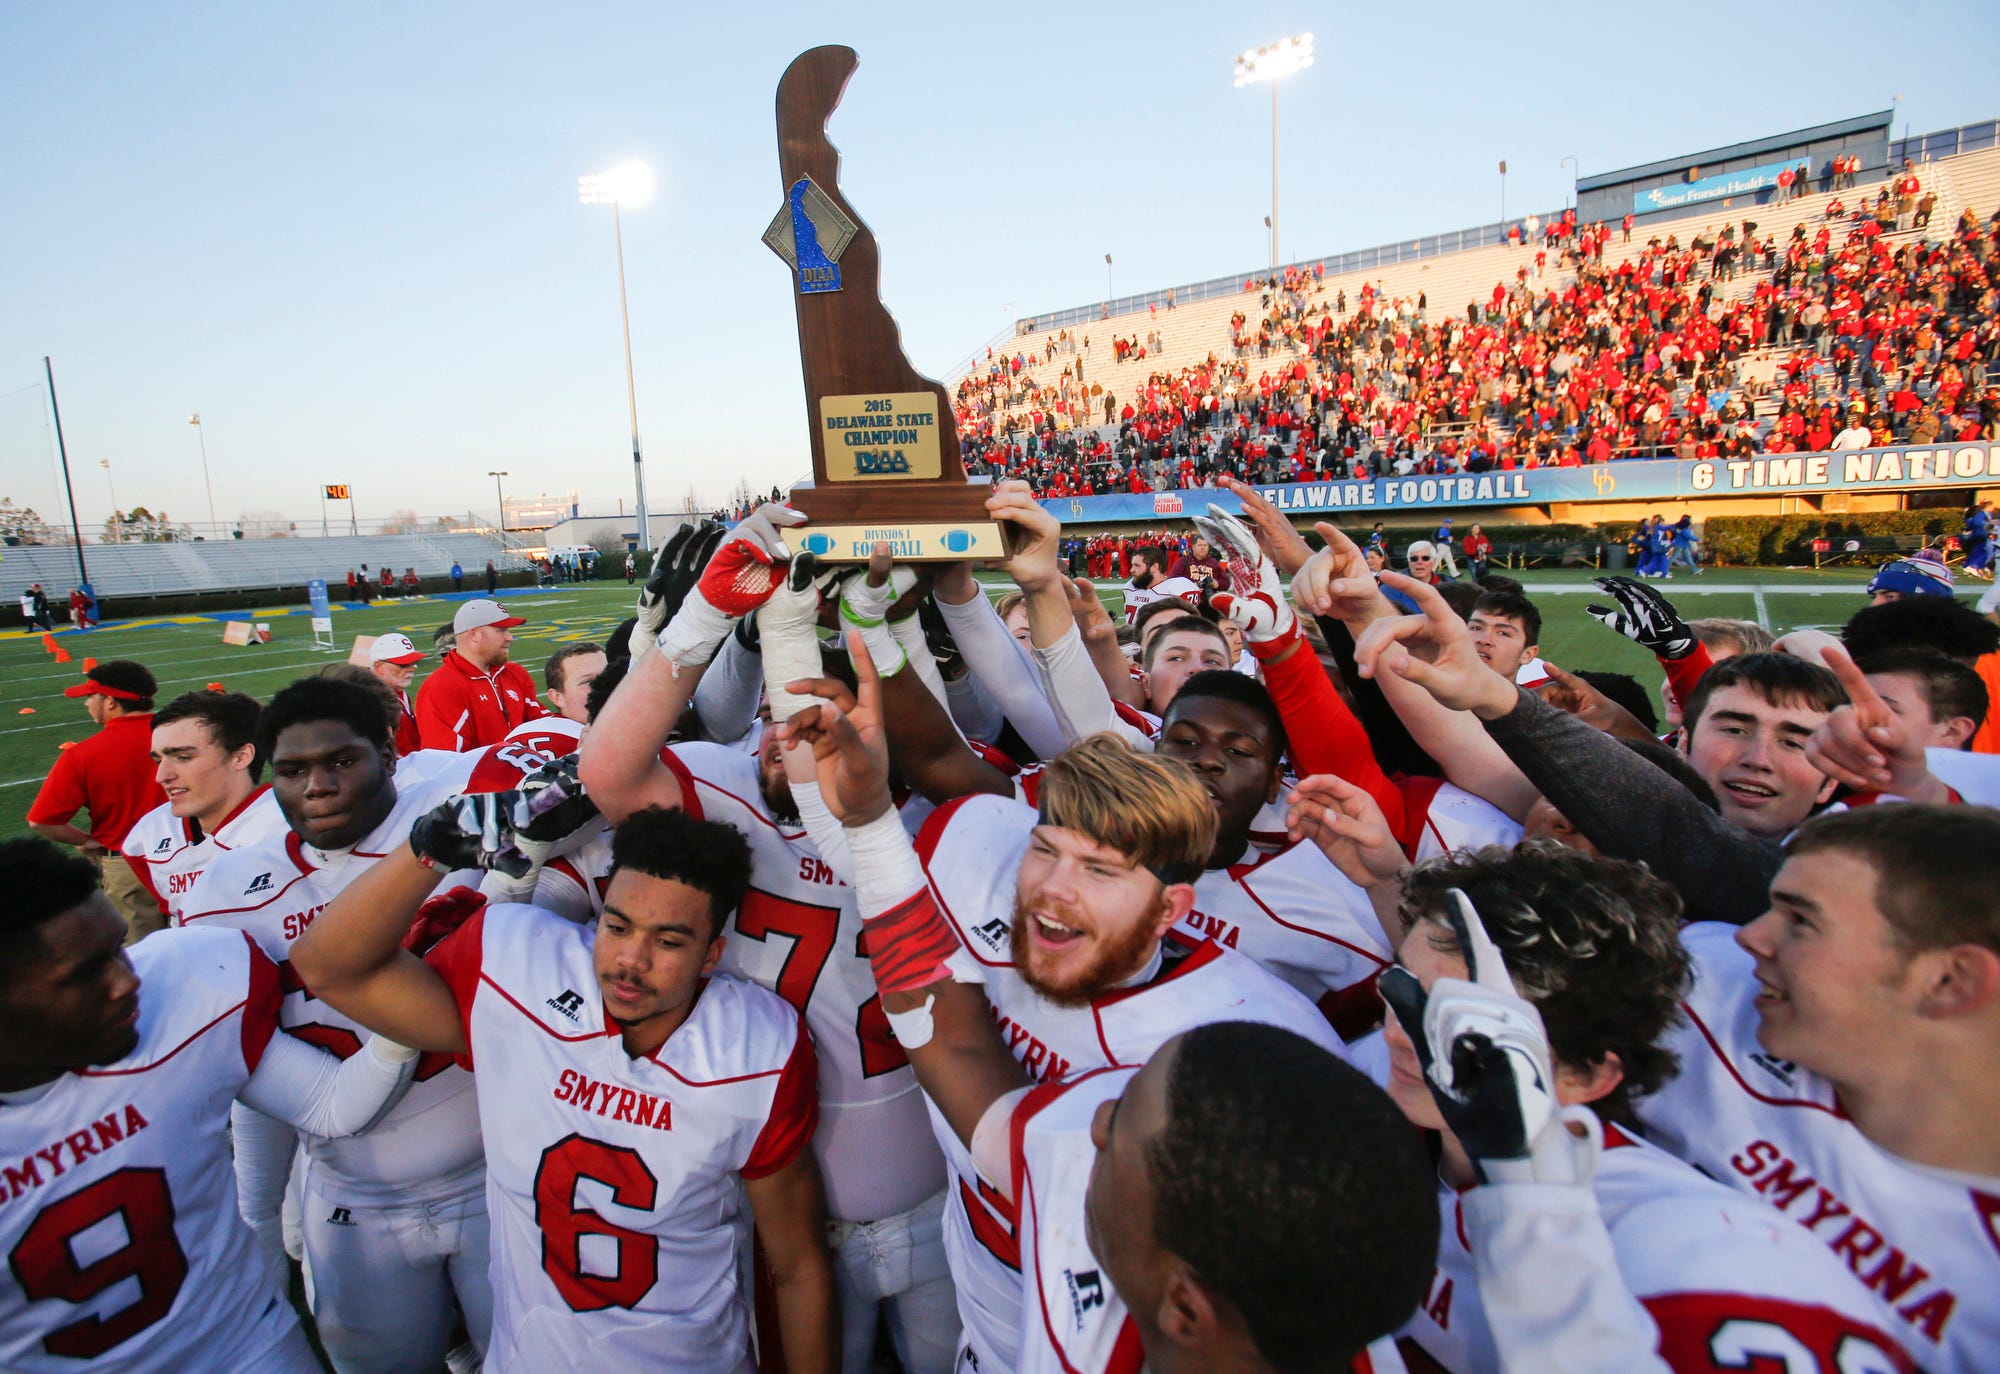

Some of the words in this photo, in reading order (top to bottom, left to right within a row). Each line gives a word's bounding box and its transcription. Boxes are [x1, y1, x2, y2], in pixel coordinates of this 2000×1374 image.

[1687, 187, 1726, 203] Francis
[803, 267, 835, 282] DIAA
[864, 399, 893, 412] 2015
[826, 415, 893, 429] DELAWARE
[896, 413, 934, 426] STATE
[844, 429, 918, 446] CHAMPION
[1691, 463, 1715, 490] 6
[1727, 456, 1829, 488] TIME
[327, 485, 348, 499] 40
[1254, 483, 1376, 509] ELAWARE
[1385, 474, 1531, 504] FOOTBALL
[1155, 503, 1182, 513] GUARD
[865, 529, 904, 540] DIVISION
[401, 638, 413, 650] S
[243, 883, 275, 896] RUSSELL
[971, 925, 1001, 953] RUSSELL
[546, 998, 581, 1022] RUSSELL
[554, 1069, 673, 1131] SMYRNA
[533, 1132, 660, 1313] 6
[1730, 1140, 1957, 1345] SMYRNA
[8, 1166, 190, 1360] 9
